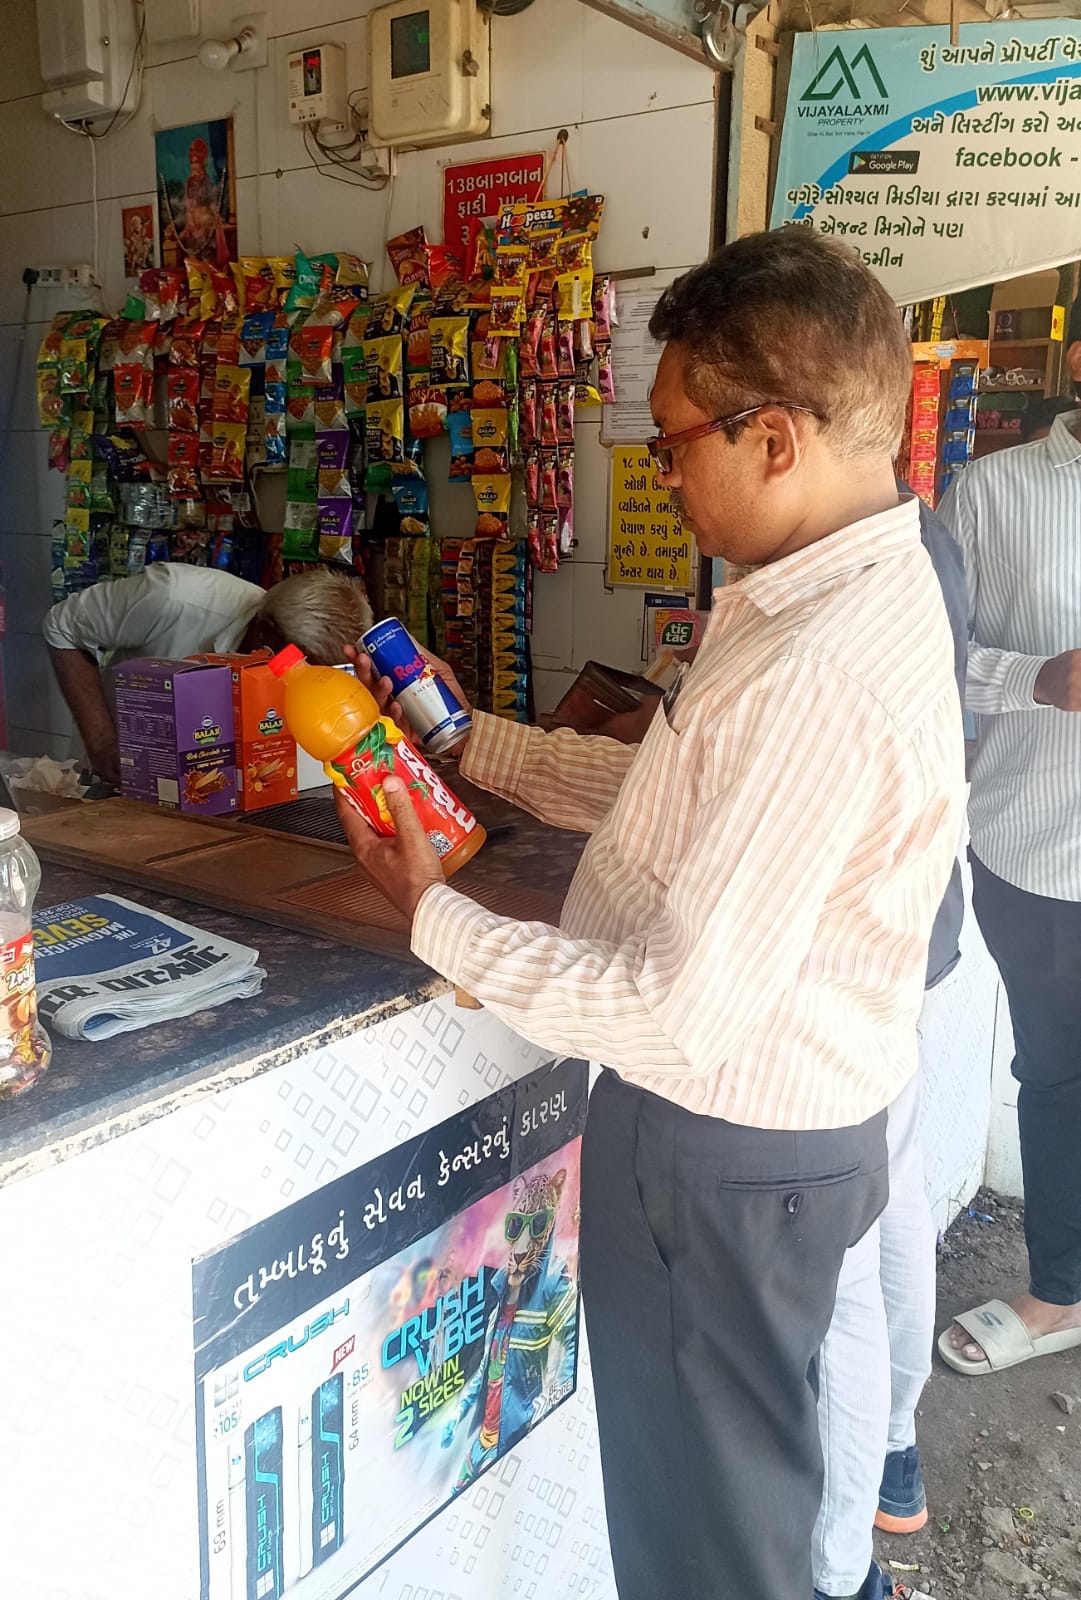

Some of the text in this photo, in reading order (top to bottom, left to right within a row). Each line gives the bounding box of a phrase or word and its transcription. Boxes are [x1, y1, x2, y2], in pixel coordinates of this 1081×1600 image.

[920, 43, 936, 71] શું
[942, 41, 995, 63] આપને
[797, 104, 889, 117] VIJAYALAXMI
[818, 118, 864, 126] PROPERTY
[912, 113, 944, 134] અને
[1021, 111, 1049, 133] કરો
[869, 160, 914, 170] Google Play
[955, 146, 1063, 167] facebook
[886, 185, 940, 206] મિડીયા
[986, 185, 1049, 207] કરવામાં
[820, 215, 867, 235] એજન્ટ
[874, 216, 926, 236] મિત્રોને
[933, 223, 964, 238] પણ
[665, 632, 687, 643] tac
[670, 623, 690, 635] tic
[398, 740, 477, 834] maaza
[112, 929, 139, 942] THE
[363, 1173, 426, 1230] સેવન
[437, 1115, 511, 1187] કેન્સરનું
[520, 1090, 568, 1137] કારણ
[381, 1265, 485, 1369] CRUSH
[243, 1298, 350, 1382] CRUSH
[335, 1337, 354, 1361] NEW
[401, 1371, 441, 1406] NOW
[443, 1354, 460, 1380] IN
[394, 1405, 416, 1449] 2
[419, 1372, 466, 1418] SIZES
[320, 1451, 331, 1523] CRUSH
[213, 1498, 226, 1554] 69 mm
[257, 1494, 267, 1572] CRUSH
